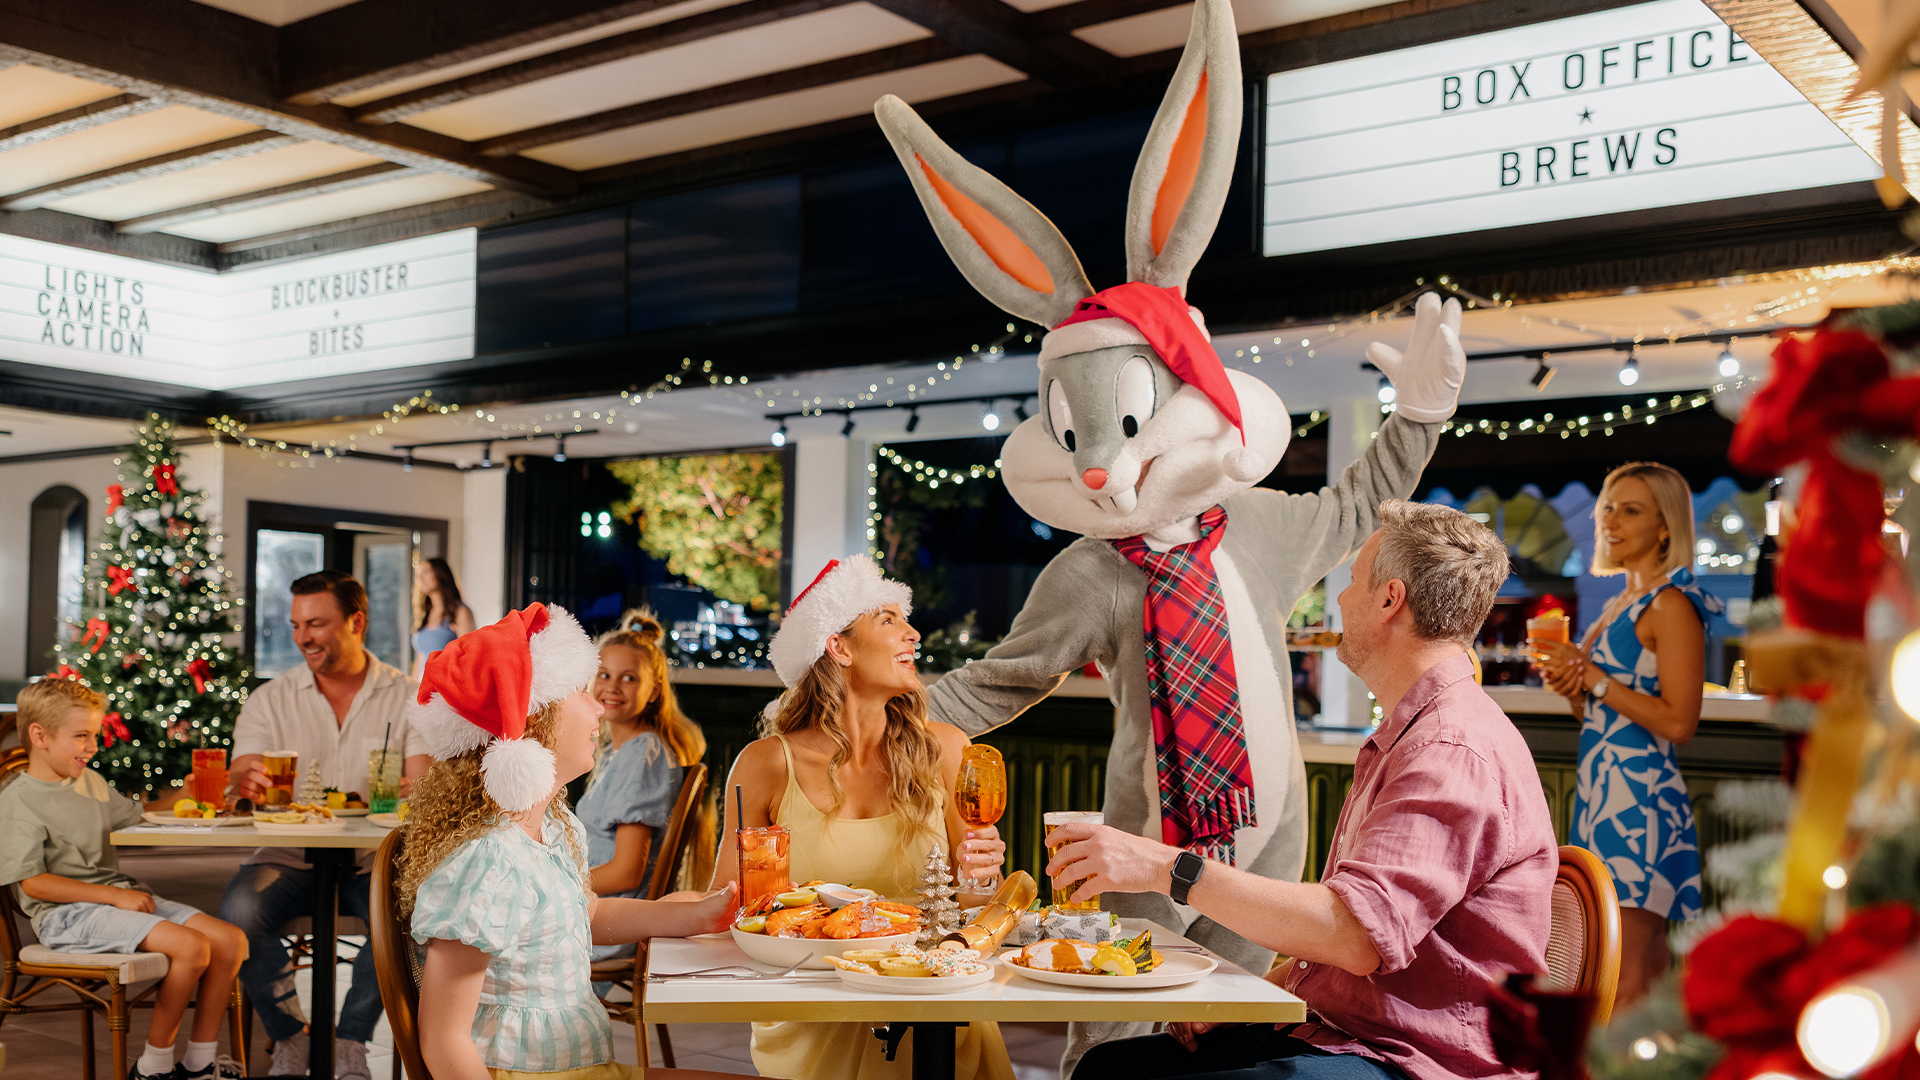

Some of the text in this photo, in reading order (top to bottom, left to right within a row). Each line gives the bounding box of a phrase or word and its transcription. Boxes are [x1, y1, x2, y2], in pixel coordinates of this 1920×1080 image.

[1443, 29, 1749, 111] BOX OFFICE
[1501, 128, 1677, 187] BREWS
[45, 265, 144, 306] LIGHTS
[272, 264, 409, 309] BLOCKBUSTER
[37, 292, 150, 332] CAMERA
[41, 321, 144, 357] ACTION
[310, 325, 364, 355] BITES
